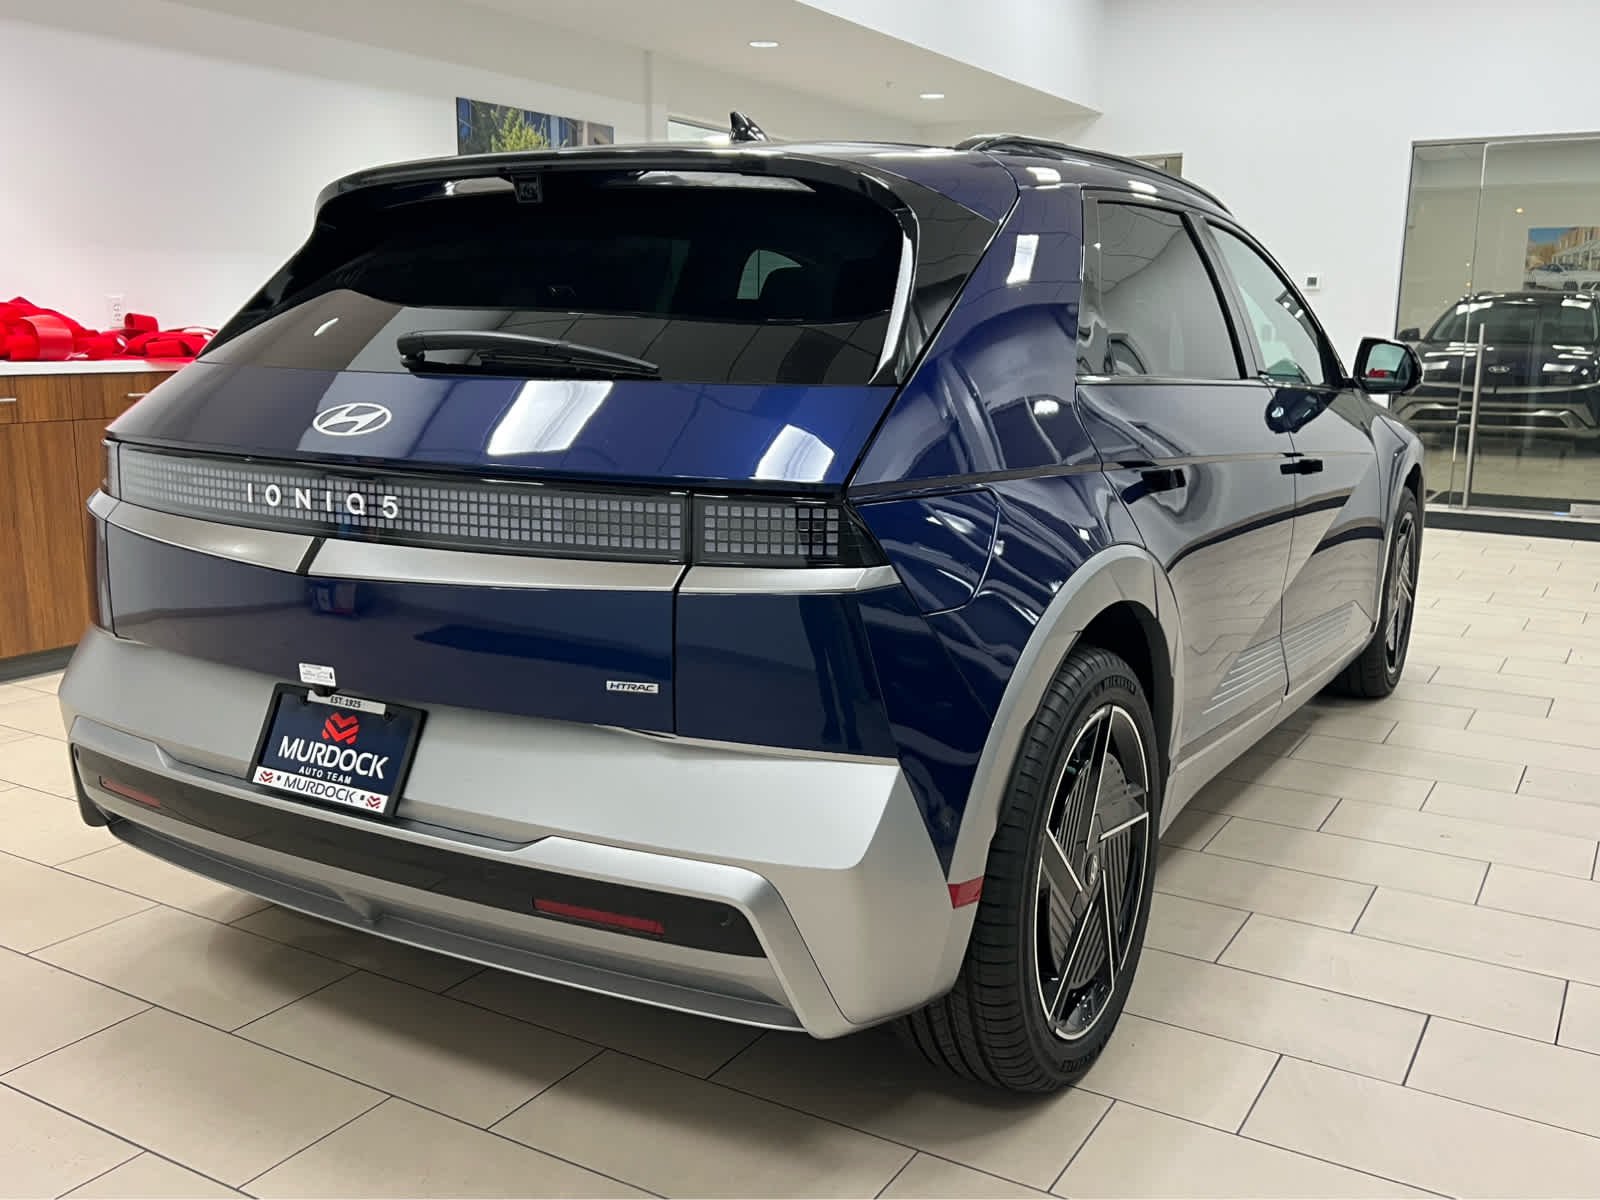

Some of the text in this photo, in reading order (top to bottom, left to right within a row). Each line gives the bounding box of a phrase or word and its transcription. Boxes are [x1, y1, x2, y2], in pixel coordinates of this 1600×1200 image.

[247, 482, 399, 519] IONIQ 5
[608, 682, 658, 692] HTRAC
[278, 735, 389, 779] MURDOCK
[284, 775, 357, 804] MURDOCK
[299, 765, 352, 785] AUTO TEAM
